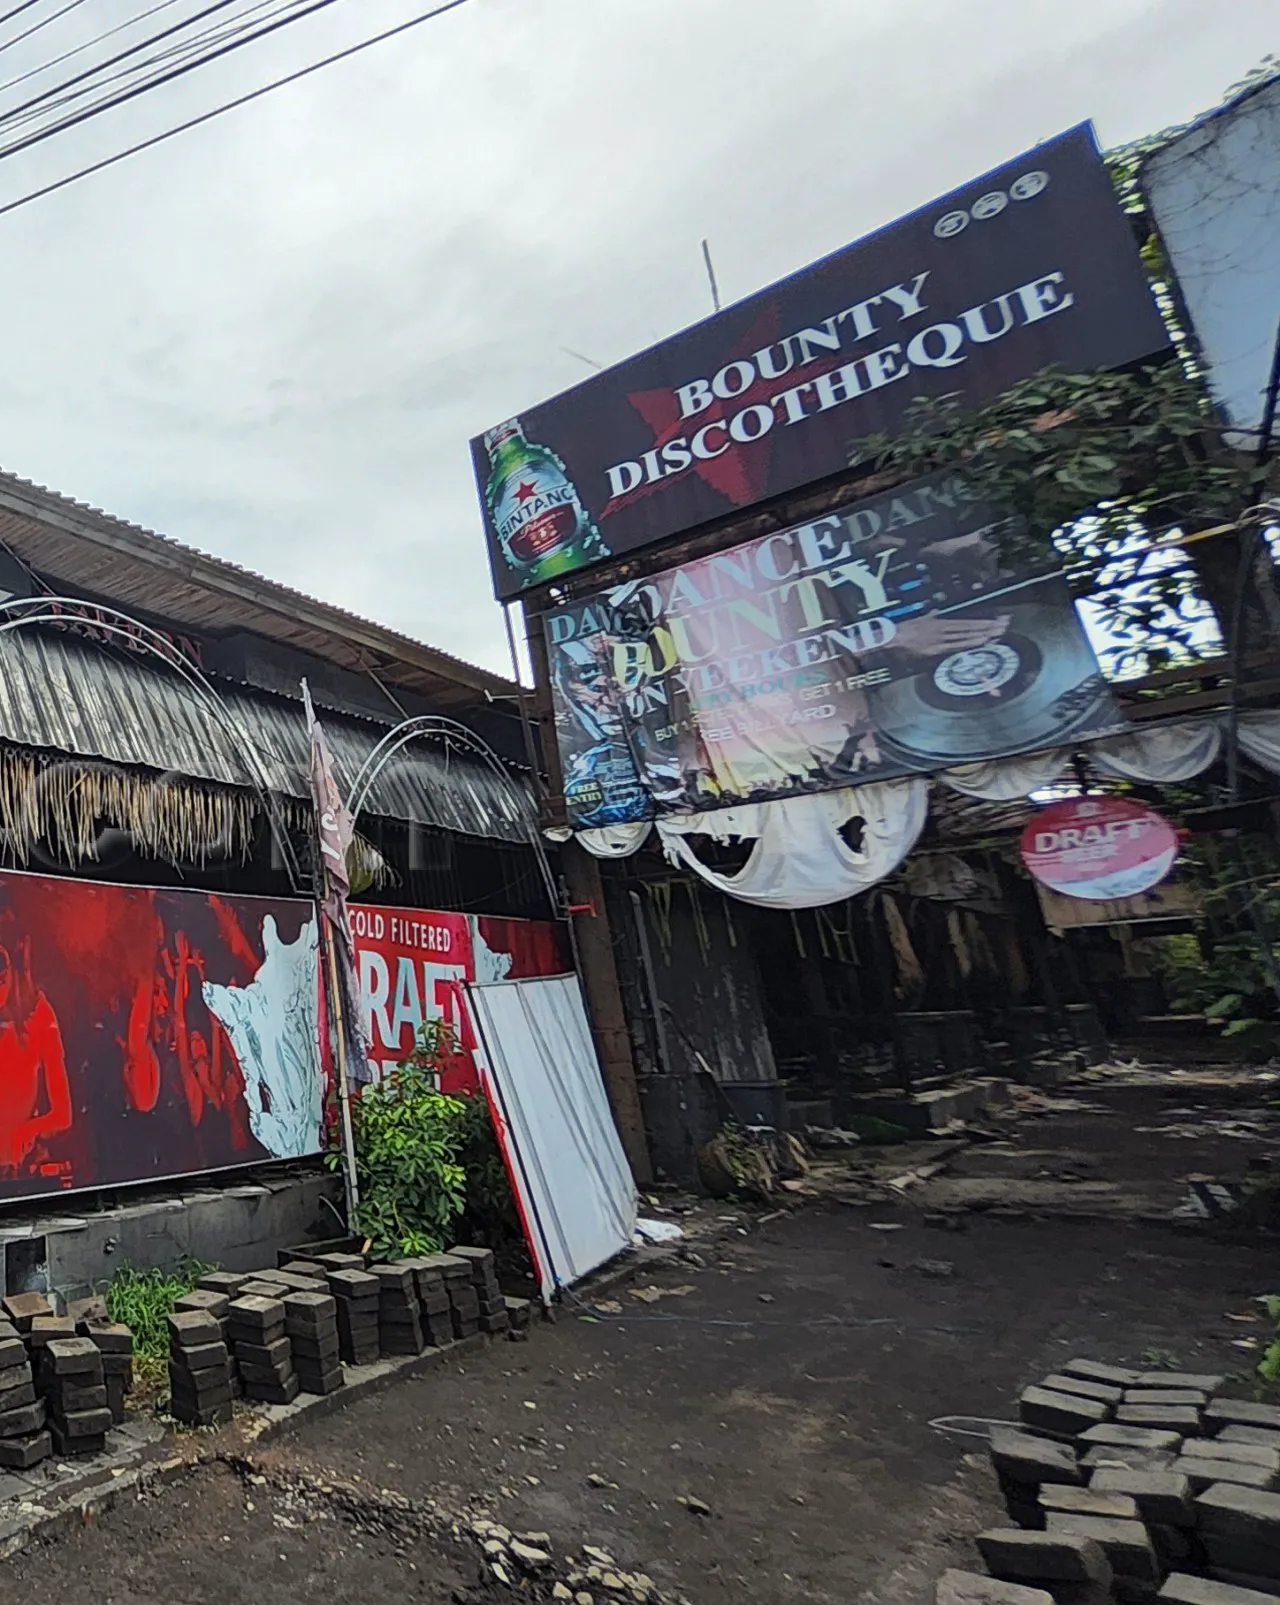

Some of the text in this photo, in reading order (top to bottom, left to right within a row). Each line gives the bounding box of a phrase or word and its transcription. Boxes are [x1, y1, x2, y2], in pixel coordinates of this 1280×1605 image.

[677, 272, 932, 422] BOUNTY
[604, 272, 1075, 500] DISCOTHEQUE
[500, 488, 574, 541] BINTANG
[798, 683, 831, 702] GET
[845, 668, 892, 691] FREE
[654, 724, 679, 742] BUY
[1034, 818, 1144, 852] DRAFT
[347, 909, 452, 952] COLD FILTERED
